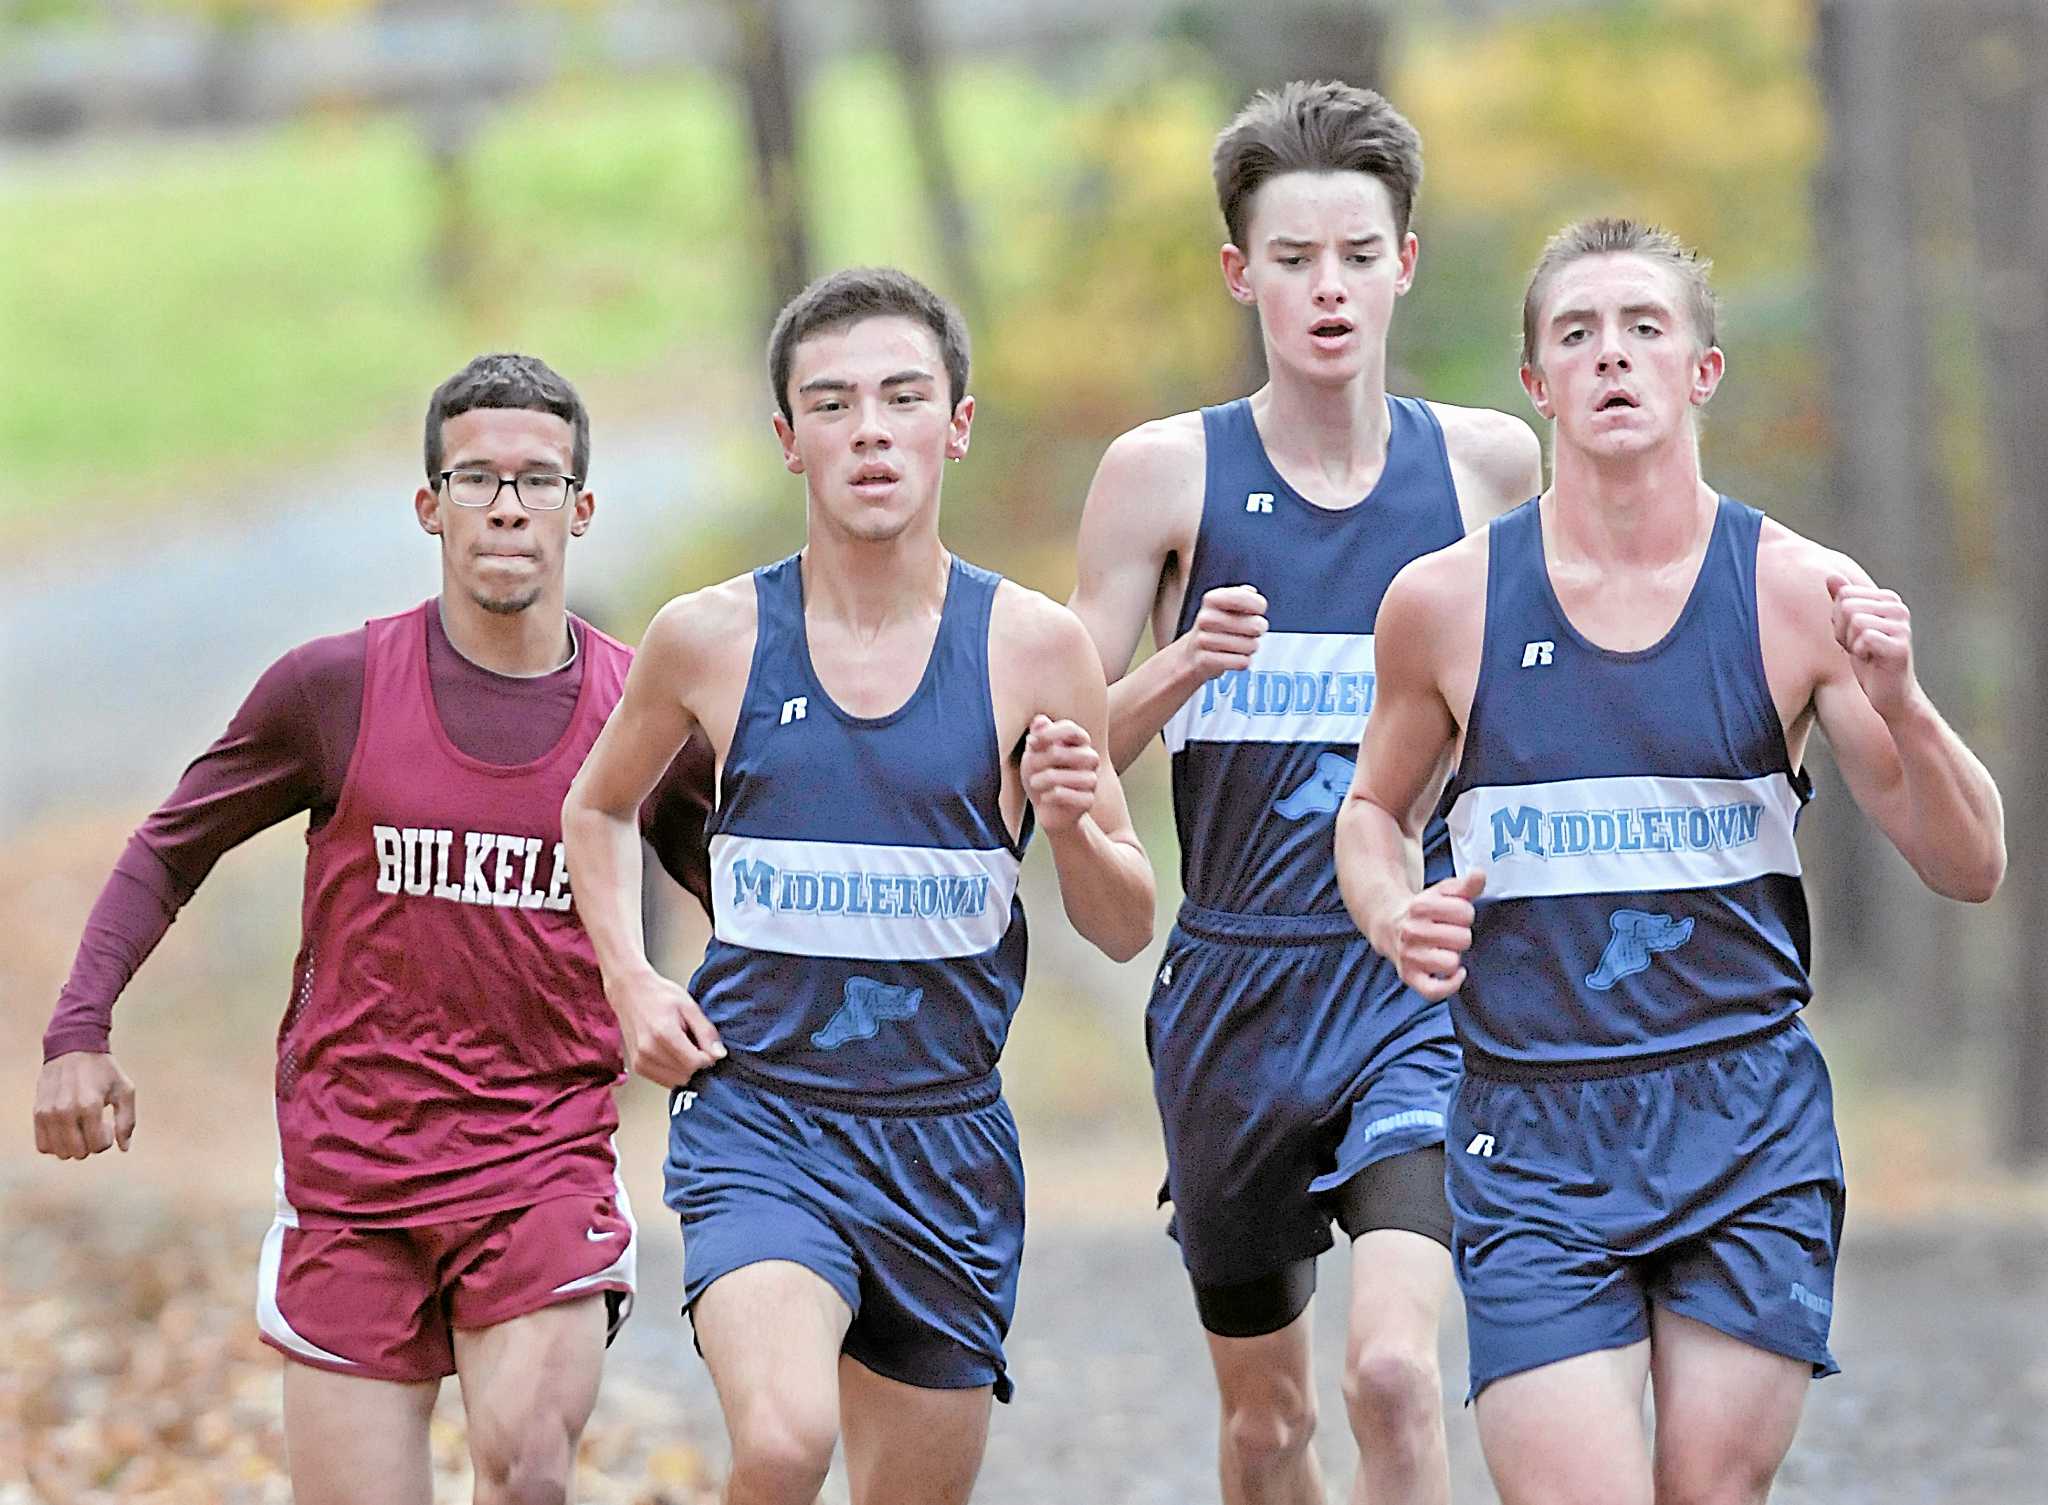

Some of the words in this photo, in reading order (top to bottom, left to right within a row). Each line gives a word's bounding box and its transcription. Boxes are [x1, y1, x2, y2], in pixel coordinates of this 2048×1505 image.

[1245, 493, 1274, 513] R
[1521, 640, 1555, 668] R
[779, 696, 808, 725] R
[1490, 804, 1765, 863] MIDDLETOWN
[732, 858, 990, 919] MIDDLETOWN
